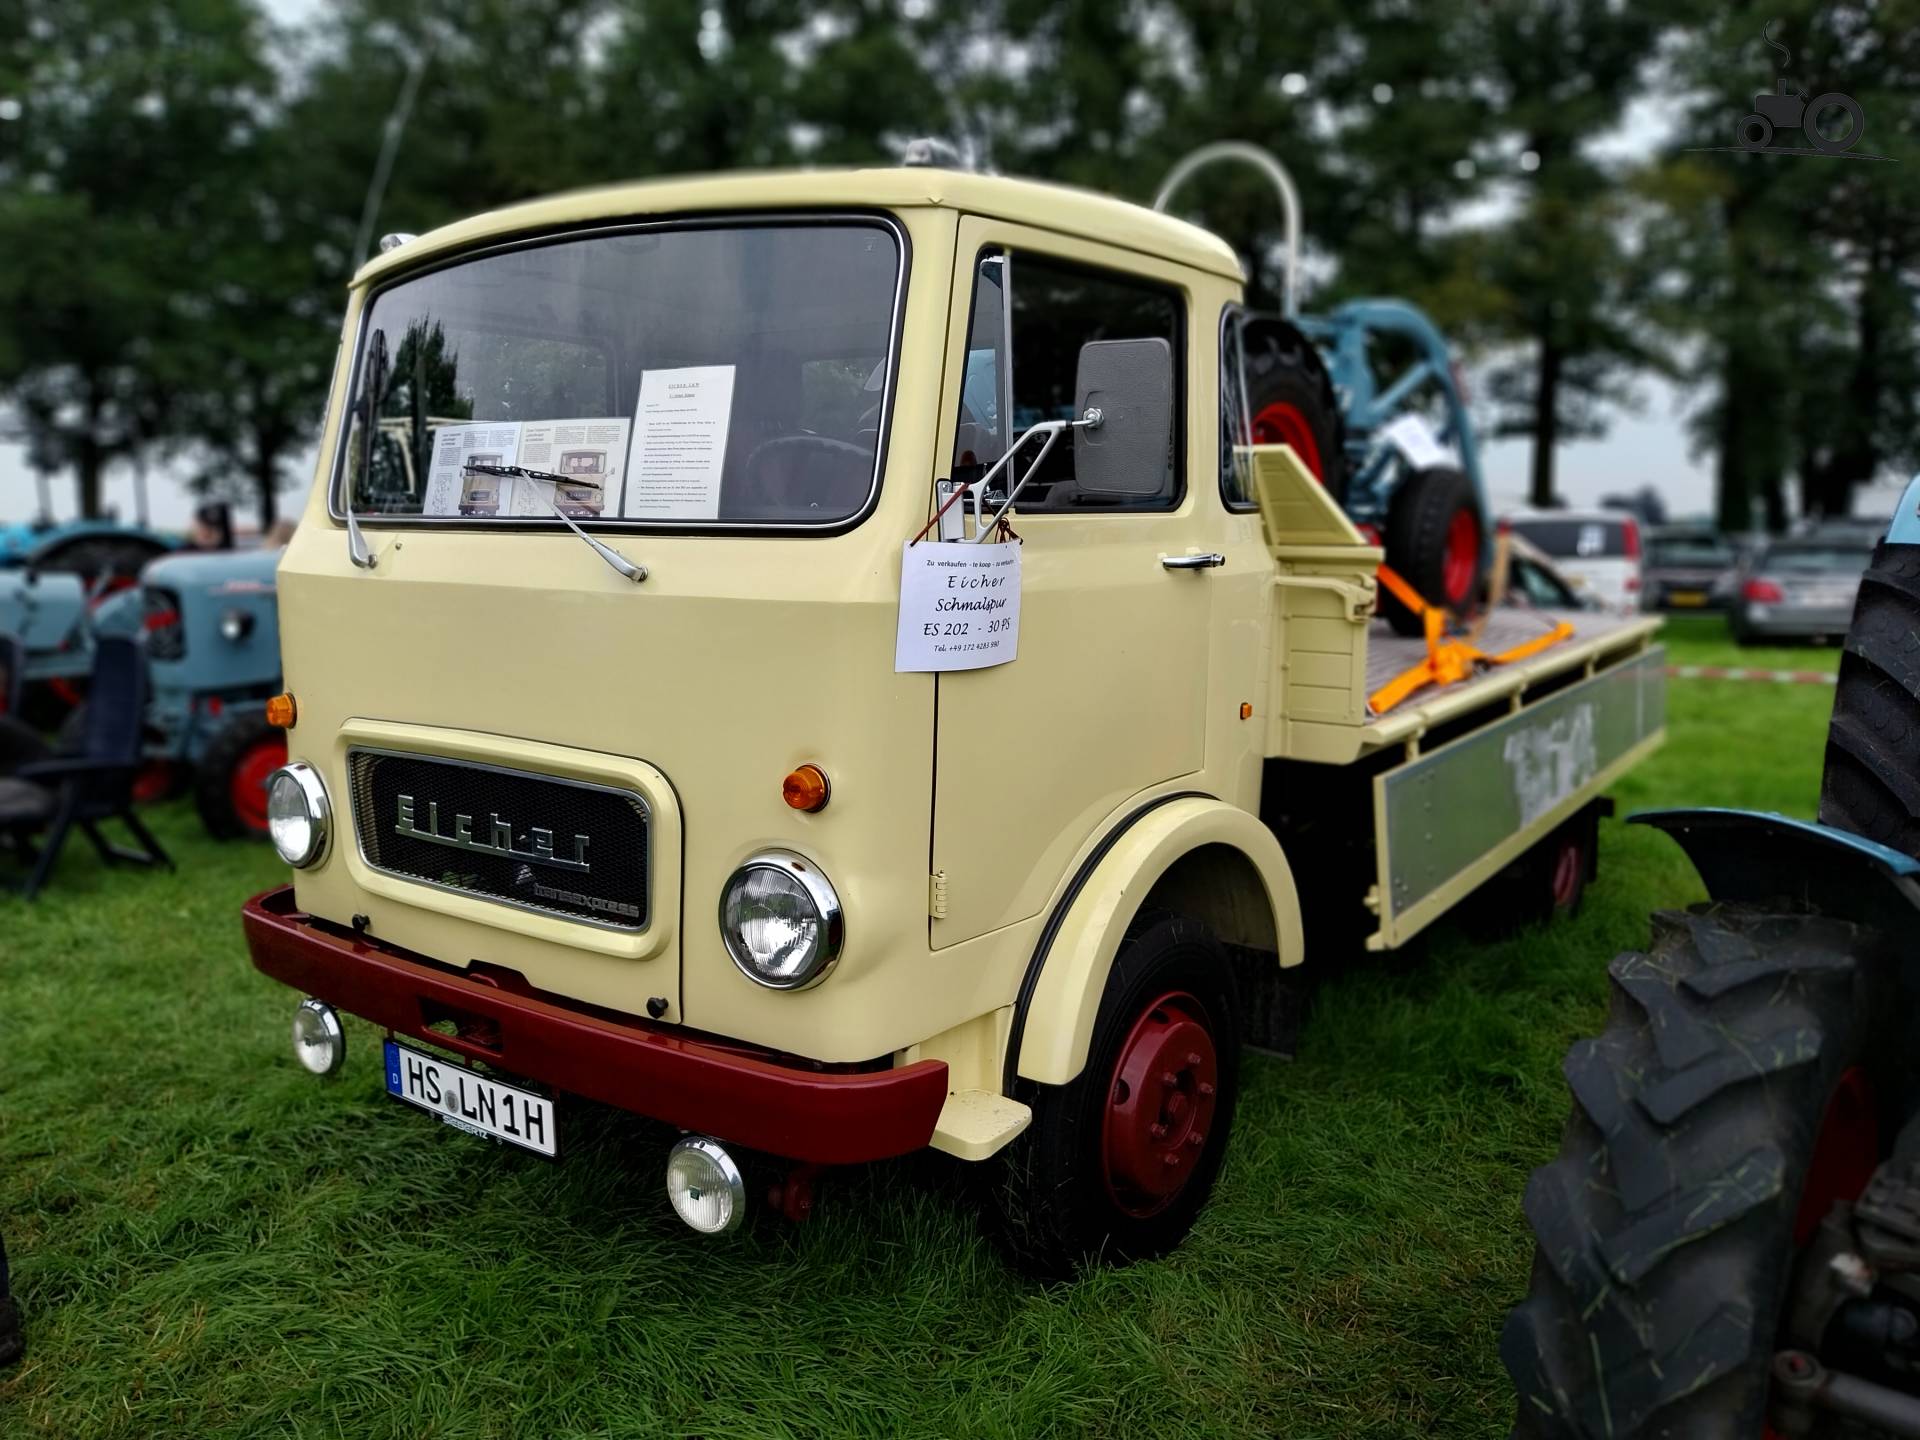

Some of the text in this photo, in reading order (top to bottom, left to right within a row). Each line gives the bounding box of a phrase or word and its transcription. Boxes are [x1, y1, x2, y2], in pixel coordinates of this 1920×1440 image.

[938, 560, 966, 568] verkaufen
[948, 574, 1005, 588] Eicher
[935, 597, 1007, 614] Schmalspur
[923, 623, 940, 636] ES
[944, 622, 969, 635] 202
[987, 619, 1000, 633] 30
[1001, 617, 1011, 632] PS
[949, 644, 961, 652] +49
[396, 795, 590, 871] Eicher
[392, 1073, 399, 1084] D
[408, 1057, 441, 1104] HS
